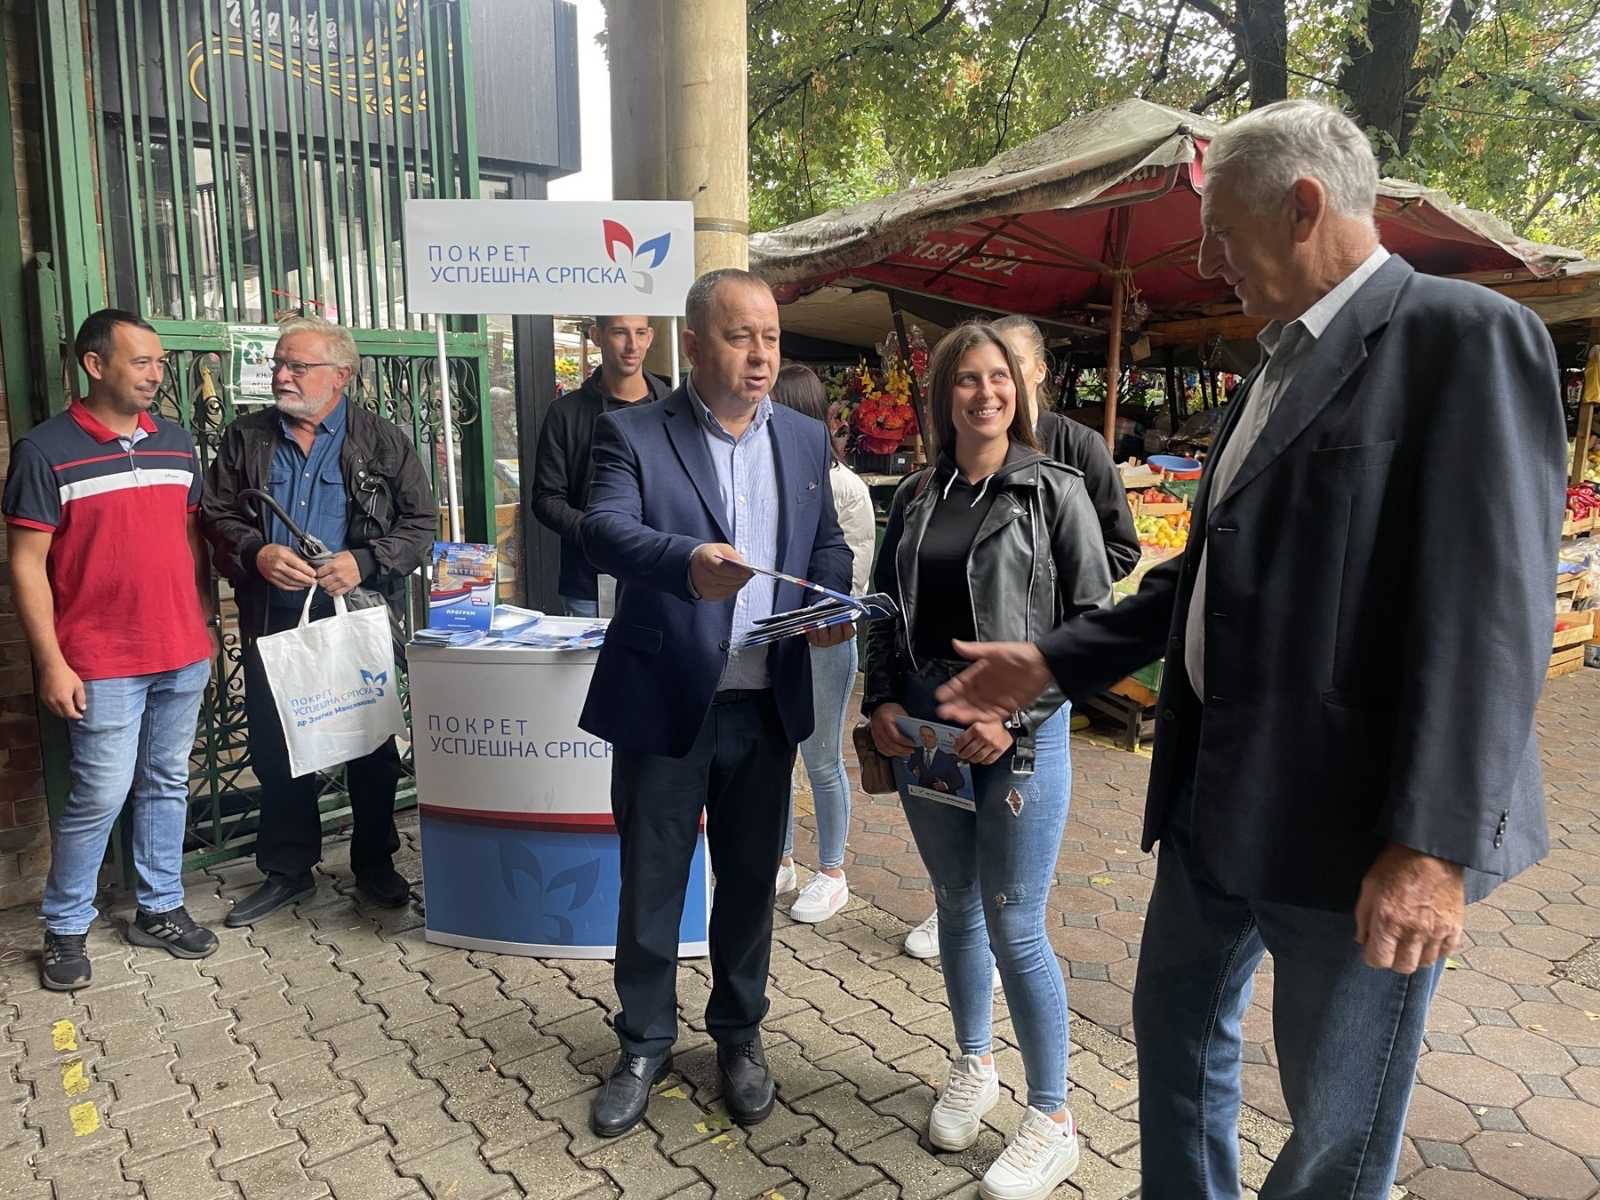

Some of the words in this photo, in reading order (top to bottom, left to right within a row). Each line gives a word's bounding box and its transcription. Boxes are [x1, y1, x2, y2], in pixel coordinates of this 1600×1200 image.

[428, 245, 530, 263] ПОКРЕТ
[431, 266, 540, 284] УСПЈЕШНА
[546, 266, 627, 284] СРПСКА
[428, 715, 528, 736] ПОКРЕТ
[430, 735, 538, 758] УСПЈЕШНА
[545, 741, 613, 758] СРПСК
